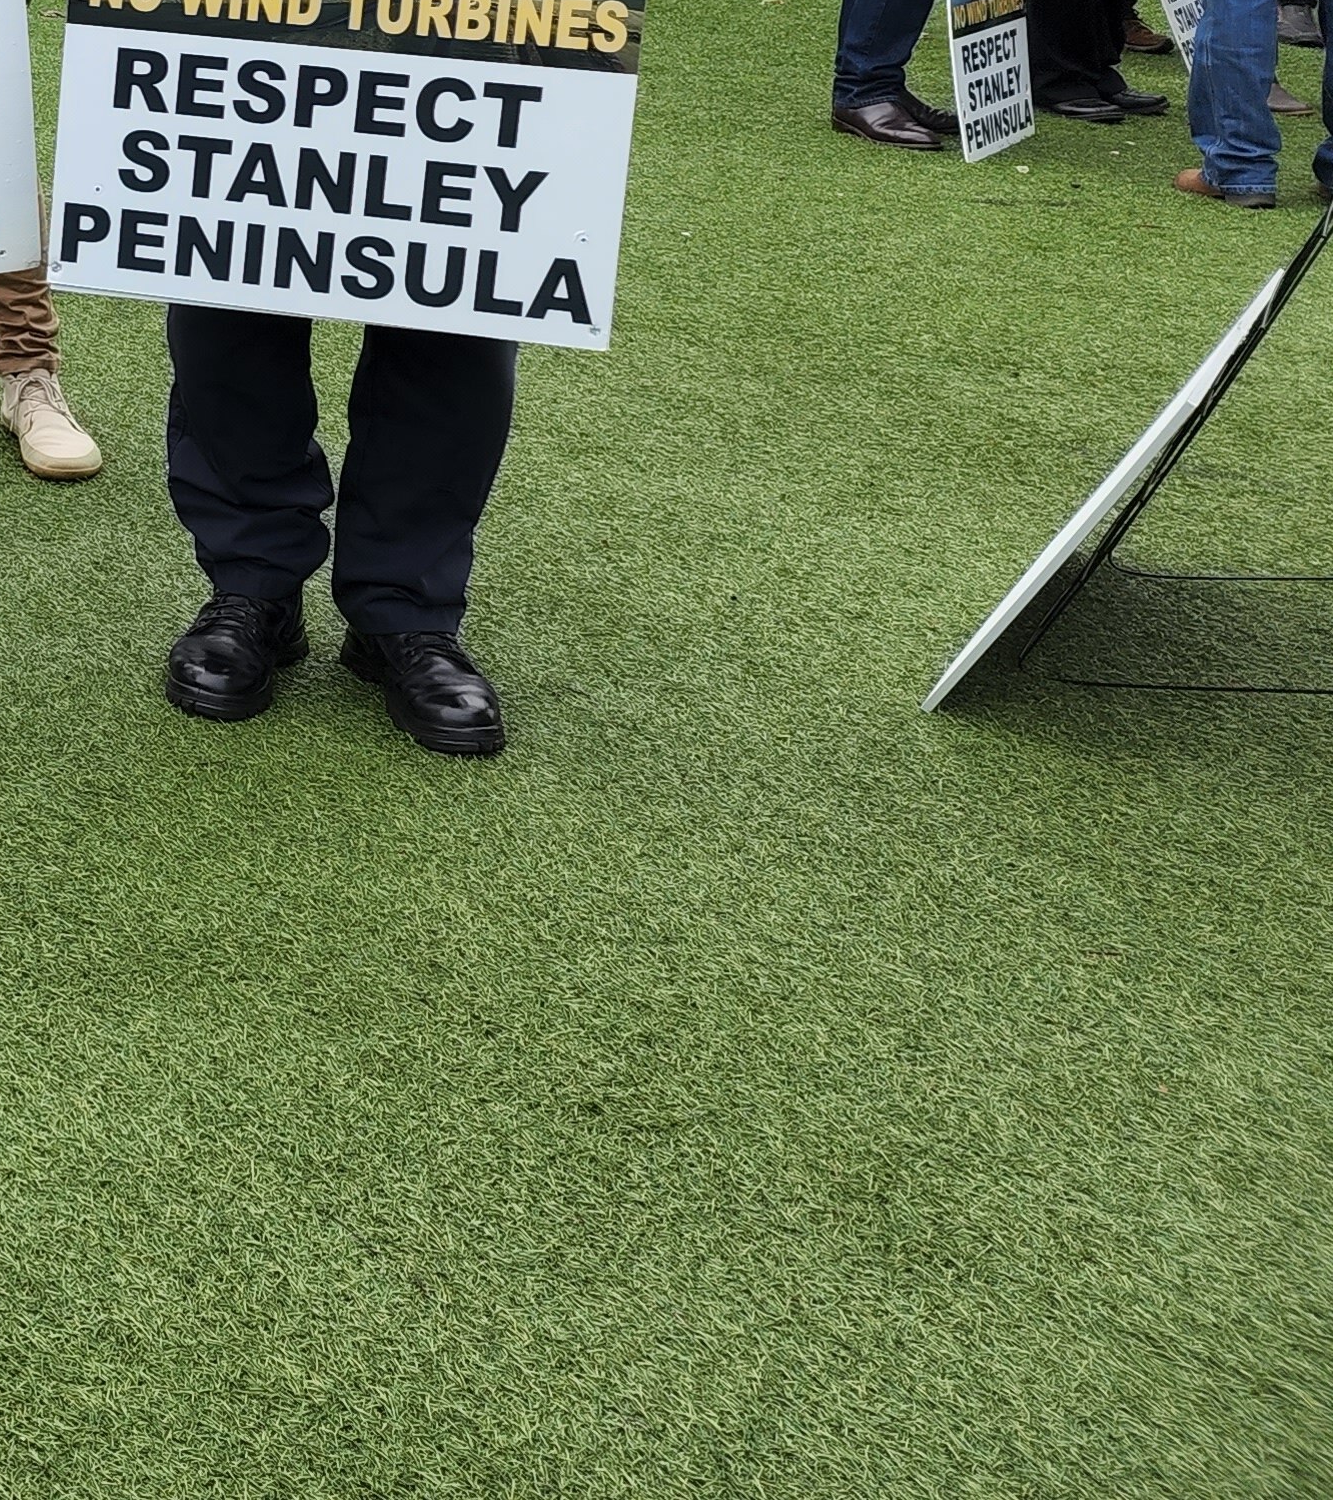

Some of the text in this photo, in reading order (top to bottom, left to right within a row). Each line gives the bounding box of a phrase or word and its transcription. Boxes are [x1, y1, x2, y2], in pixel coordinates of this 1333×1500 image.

[952, 4, 966, 31] NO
[961, 27, 1018, 76] RESPECT
[113, 47, 544, 150] RESPECT
[967, 63, 1022, 112] STANLEY
[964, 98, 1033, 153] PENINSULA
[117, 129, 550, 233] STANLEY
[60, 202, 594, 326] PENINSULA
